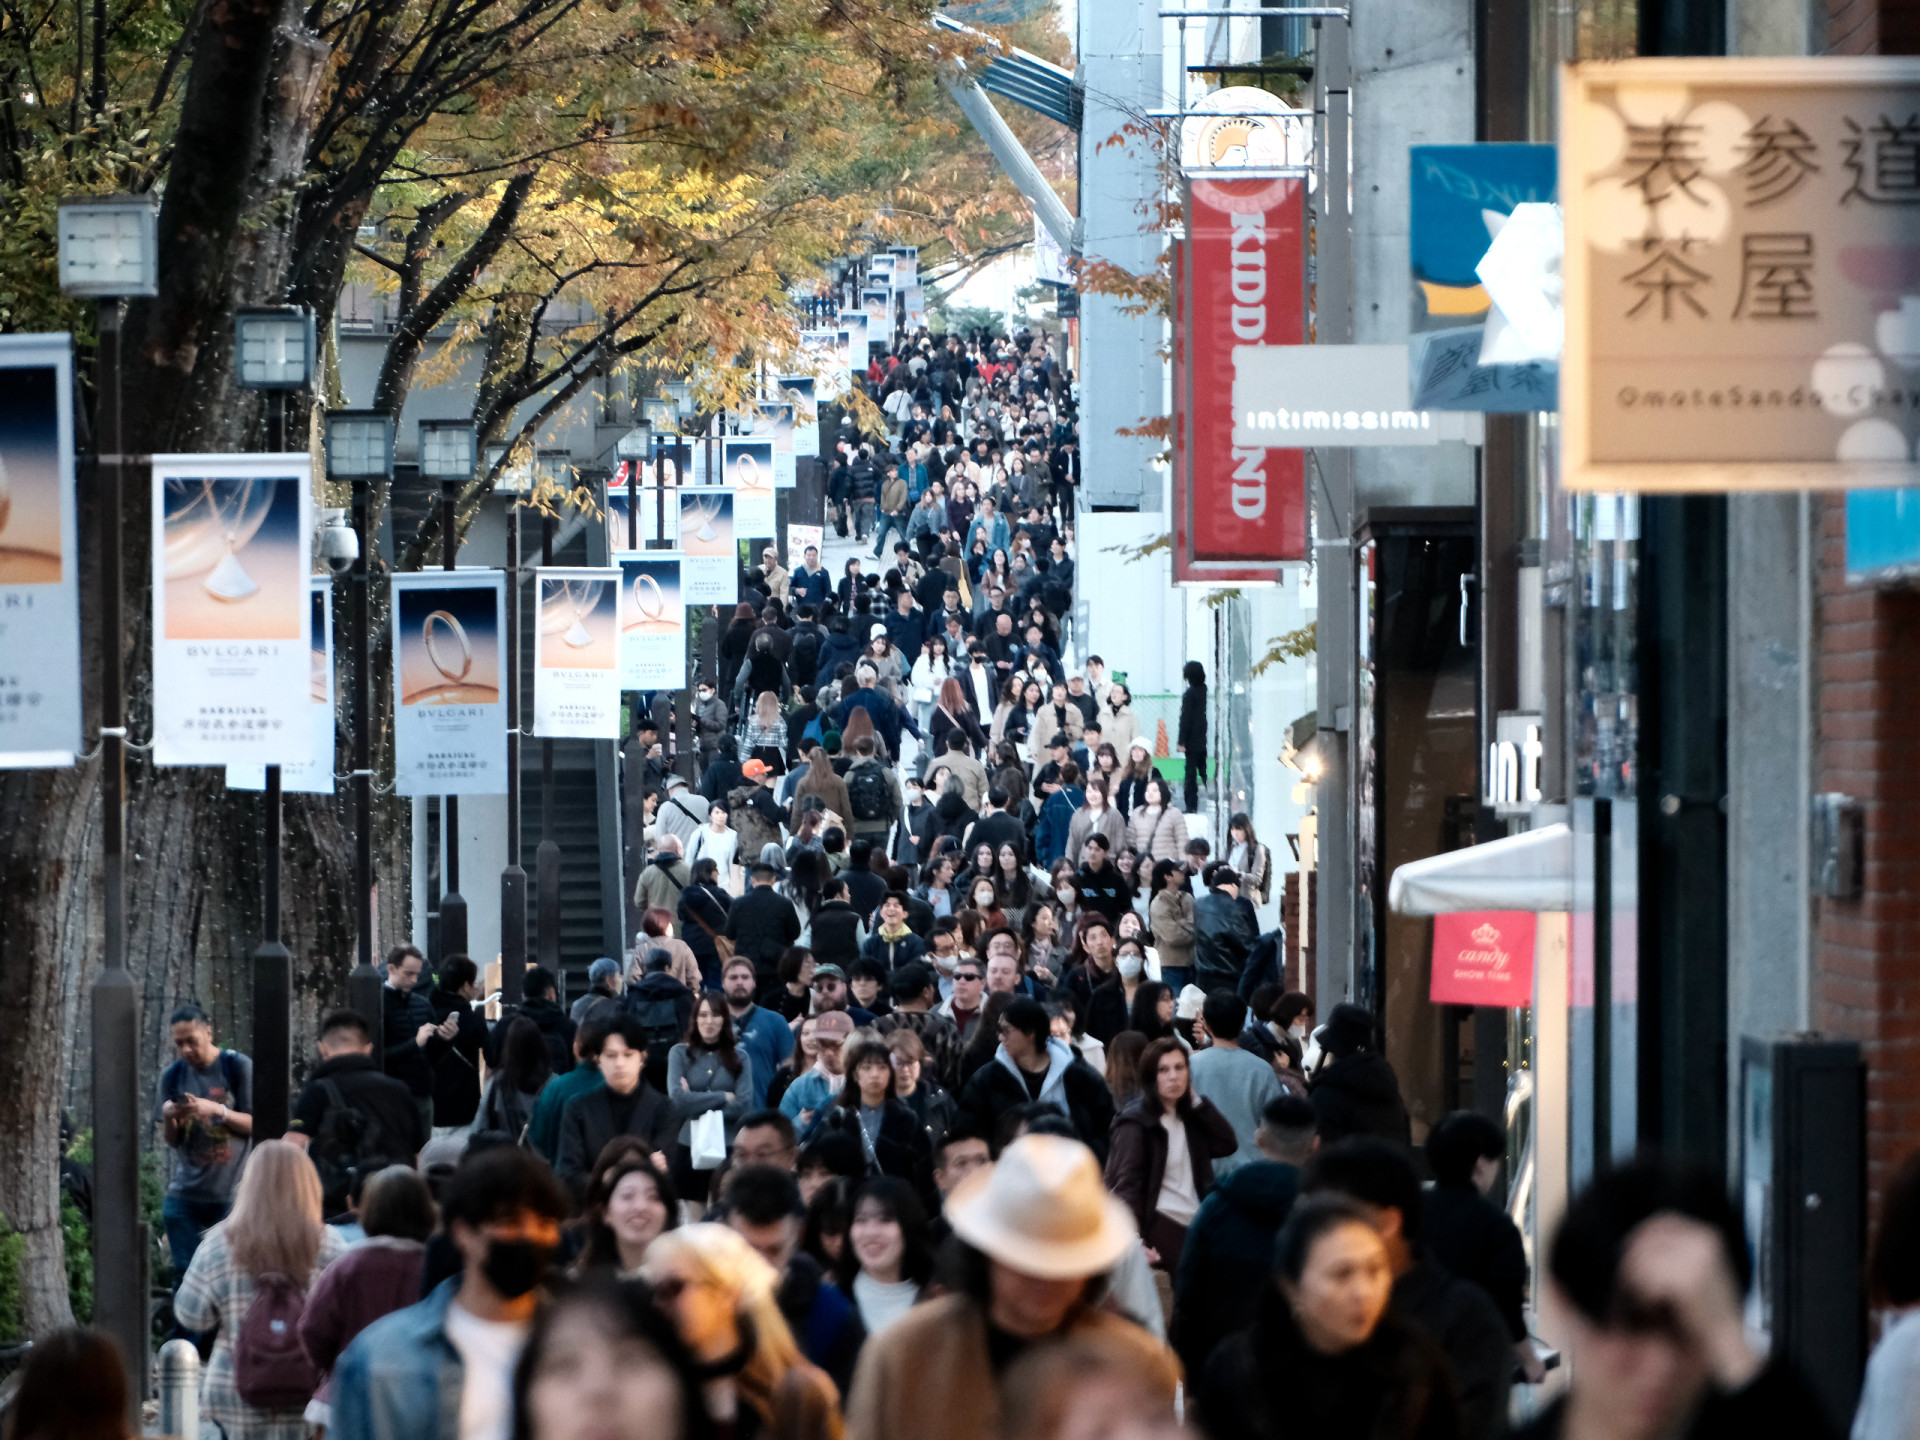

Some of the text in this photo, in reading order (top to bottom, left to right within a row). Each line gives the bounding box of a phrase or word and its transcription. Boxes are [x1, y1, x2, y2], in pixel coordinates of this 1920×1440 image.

[1621, 113, 1920, 208] 表参道
[1231, 210, 1266, 370] KIDD
[1620, 231, 1821, 323] 茶屋
[1247, 407, 1430, 430] intimissimi
[187, 646, 278, 656] BVLGARI
[418, 709, 484, 718] BVLGARI
[1489, 724, 1543, 804] int
[1458, 945, 1510, 971] candy
[1453, 968, 1513, 983] SHOW TIME
